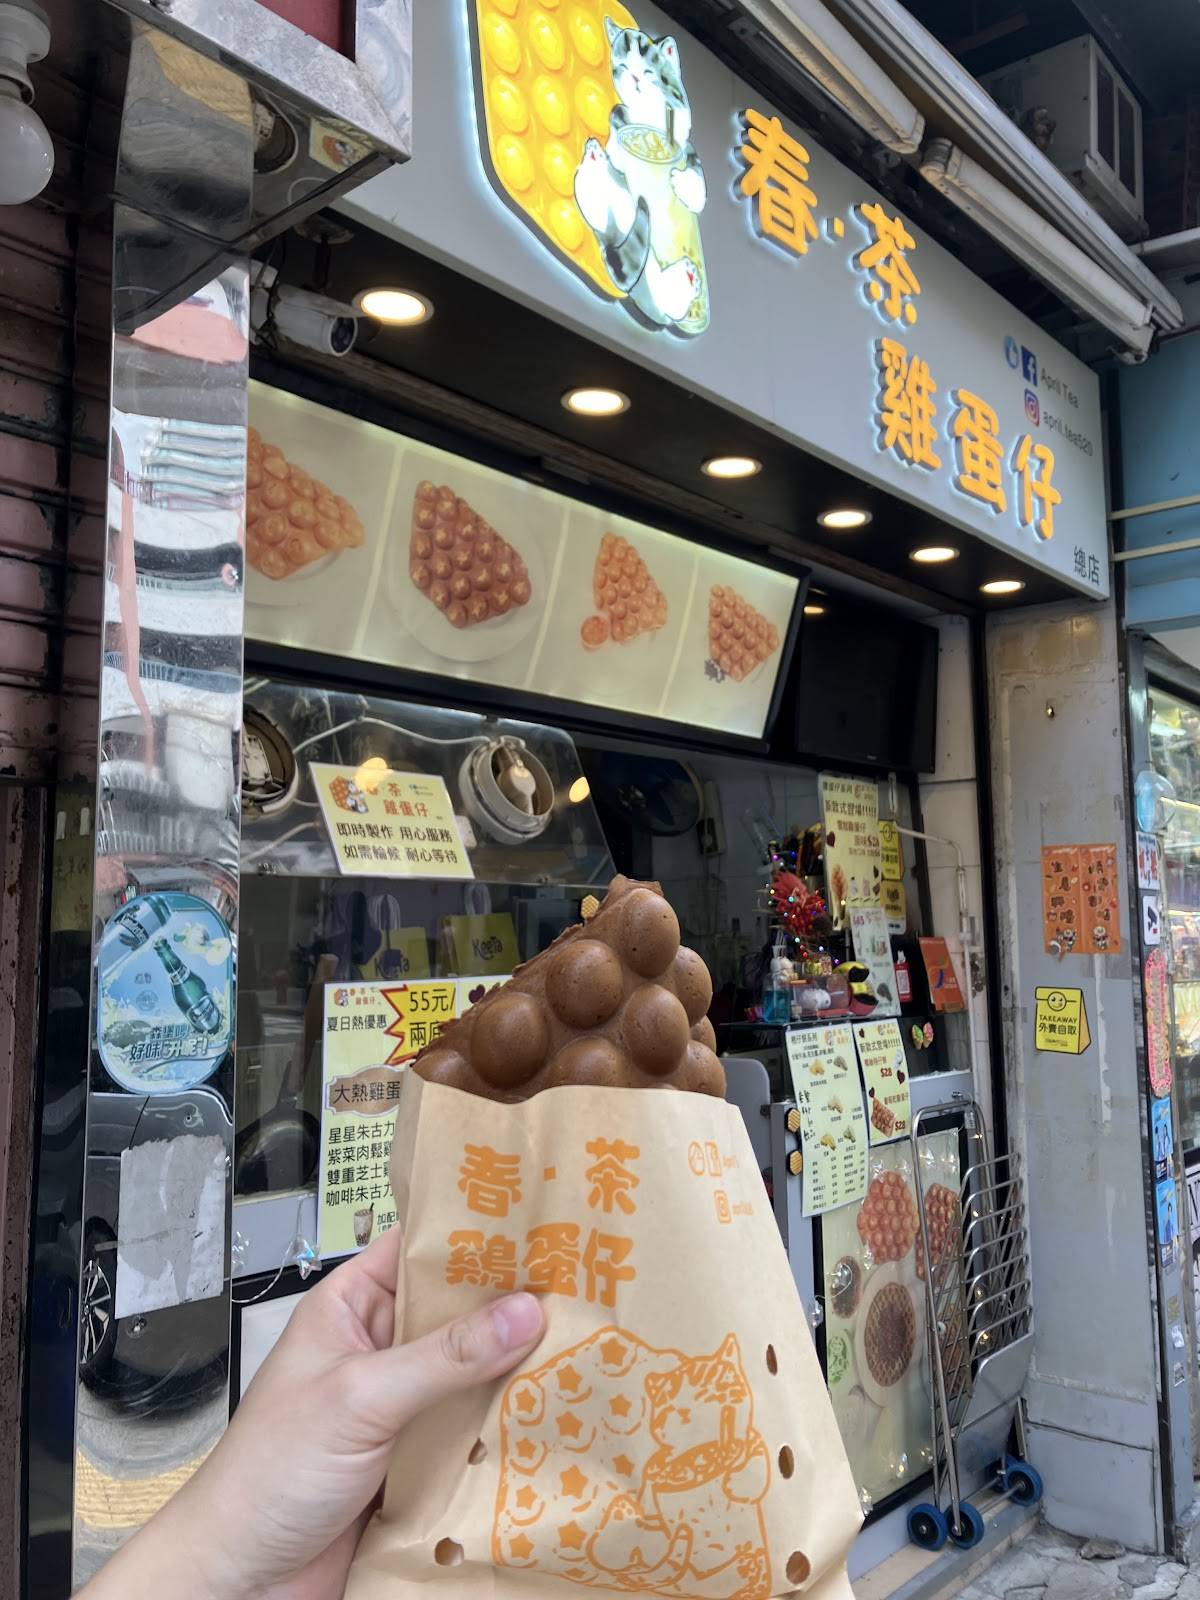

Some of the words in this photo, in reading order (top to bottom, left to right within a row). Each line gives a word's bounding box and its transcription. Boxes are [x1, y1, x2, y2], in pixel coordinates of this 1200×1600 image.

[1040, 368, 1062, 395] April
[1062, 383, 1079, 408] Tea
[876, 337, 1062, 541] 雞蛋仔
[1073, 545, 1100, 587] 總店
[336, 822, 394, 840] 即時製作
[399, 826, 453, 844] 用心服務
[343, 844, 401, 861] 如需輪候
[404, 847, 458, 864] 耐心等待
[472, 936, 503, 960] Keeta
[327, 1014, 388, 1032] 夏日熱優惠
[1038, 1022, 1078, 1036] 外賣自取
[1039, 1014, 1078, 1024] TAKEAWAY
[328, 1119, 395, 1145] 星星朱古力
